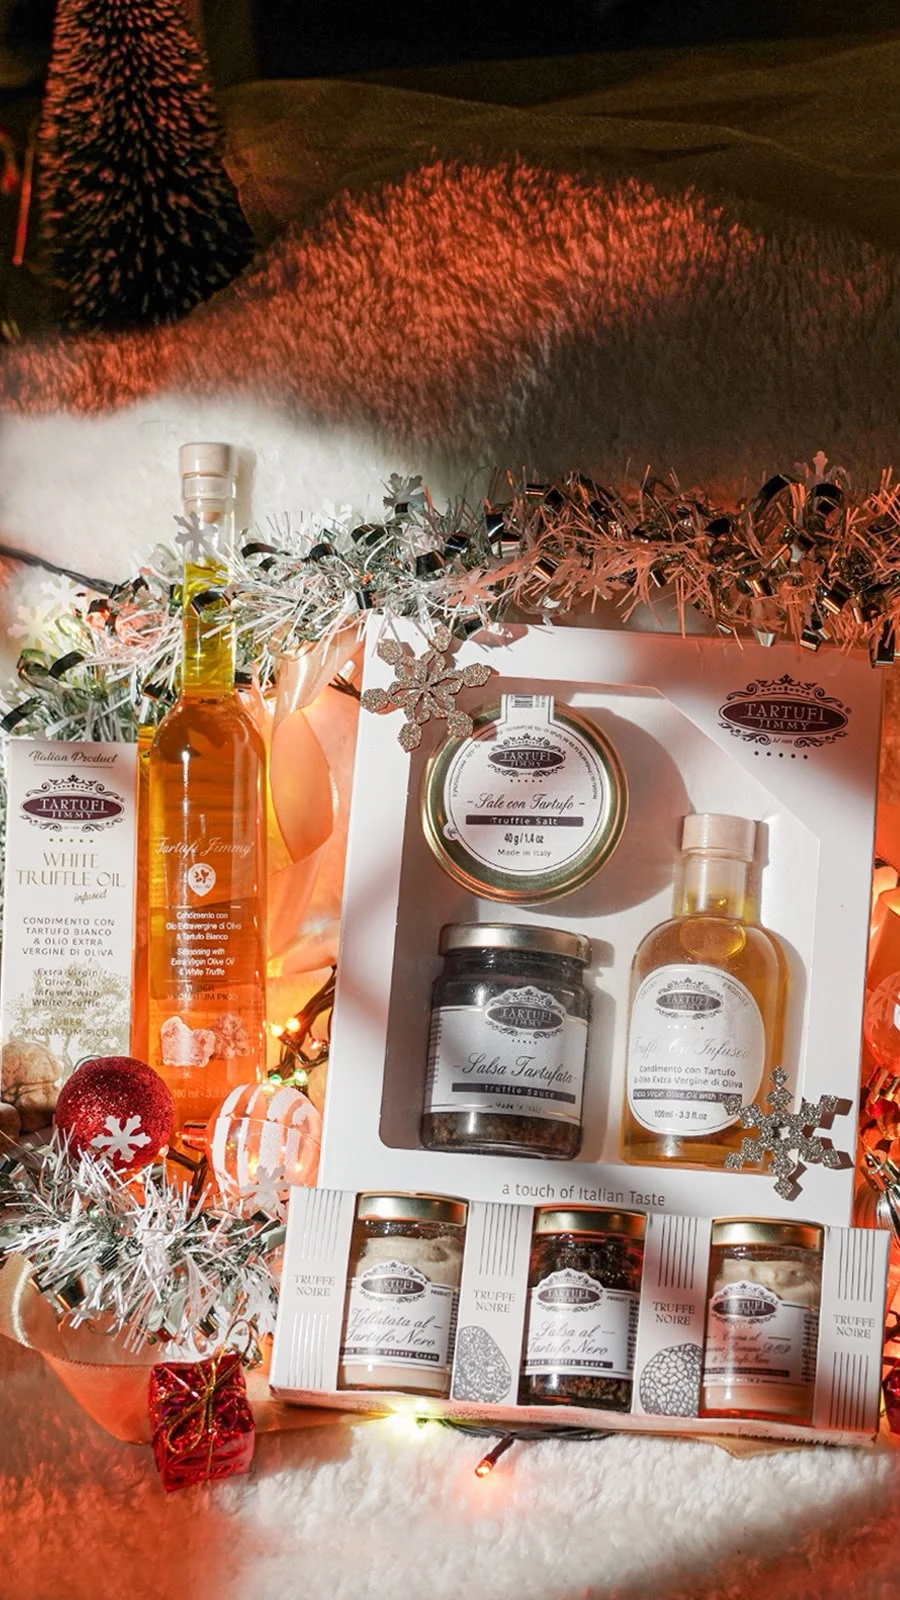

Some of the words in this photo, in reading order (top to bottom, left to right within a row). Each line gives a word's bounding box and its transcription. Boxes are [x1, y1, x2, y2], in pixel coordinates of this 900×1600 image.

[745, 704, 825, 720] TARTUFI
[759, 720, 809, 730] JIMMY
[29, 750, 68, 763] Italian
[71, 751, 118, 764] Product
[503, 751, 550, 760] TARTUFI
[39, 798, 105, 811] TARTUFI
[475, 793, 505, 809] Sale
[506, 800, 525, 809] con
[530, 794, 573, 815] Tartufo
[50, 811, 93, 819] JIMMY
[492, 817, 530, 825] Truffle
[536, 817, 558, 825] Salt
[155, 837, 198, 858] Tartufi
[201, 837, 252, 856] Jimmy
[534, 849, 551, 857] Italy
[43, 852, 99, 869] WHITE
[16, 869, 91, 887] TRUFFLE
[96, 872, 126, 888] OIL
[73, 889, 107, 904] infused
[23, 917, 90, 926] CONDIMENTO
[94, 918, 115, 927] CON
[26, 927, 70, 936] TARTUFO
[73, 928, 112, 936] BIANCO
[206, 932, 228, 940] Bianco
[33, 937, 40, 945] &
[45, 938, 68, 946] OLIO
[72, 938, 103, 946] EXTRA
[22, 948, 65, 956] VERGINE
[84, 949, 114, 957] OLIVA
[207, 958, 224, 966] Olive
[37, 968, 62, 976] Extra
[67, 968, 98, 977] Virgin
[77, 989, 100, 997] with
[32, 999, 62, 1007] White
[67, 1000, 101, 1008] Truffle
[502, 1008, 551, 1020] TARTUFI
[462, 1052, 506, 1075] Salsa
[640, 1065, 681, 1074] Condimento
[704, 1067, 735, 1077] Tartufo
[675, 1077, 708, 1086] Vergine
[711, 1078, 720, 1086] di
[722, 1079, 743, 1088] Oliva
[485, 1085, 521, 1094] Truffle
[502, 1185, 510, 1195] a
[516, 1184, 554, 1199] touch
[560, 1185, 574, 1199] of
[580, 1187, 624, 1203] Italian
[630, 1191, 665, 1206] Taste
[294, 1274, 335, 1286] TRUFFE
[372, 1279, 414, 1289] TRTUFI
[296, 1285, 331, 1297] NOIRE
[473, 1290, 516, 1302] TRUFFE
[476, 1302, 511, 1313] NOIRE
[652, 1301, 695, 1314] TRUFFE
[414, 1315, 435, 1329] al
[655, 1313, 691, 1325] NOIRE
[833, 1315, 875, 1327] TRUFFE
[536, 1320, 575, 1337] Salsa
[579, 1324, 601, 1338] al
[836, 1327, 871, 1339] NOIRE
[347, 1325, 395, 1346] Tartufo
[396, 1329, 435, 1347] Nero
[572, 1339, 608, 1355] Nero
